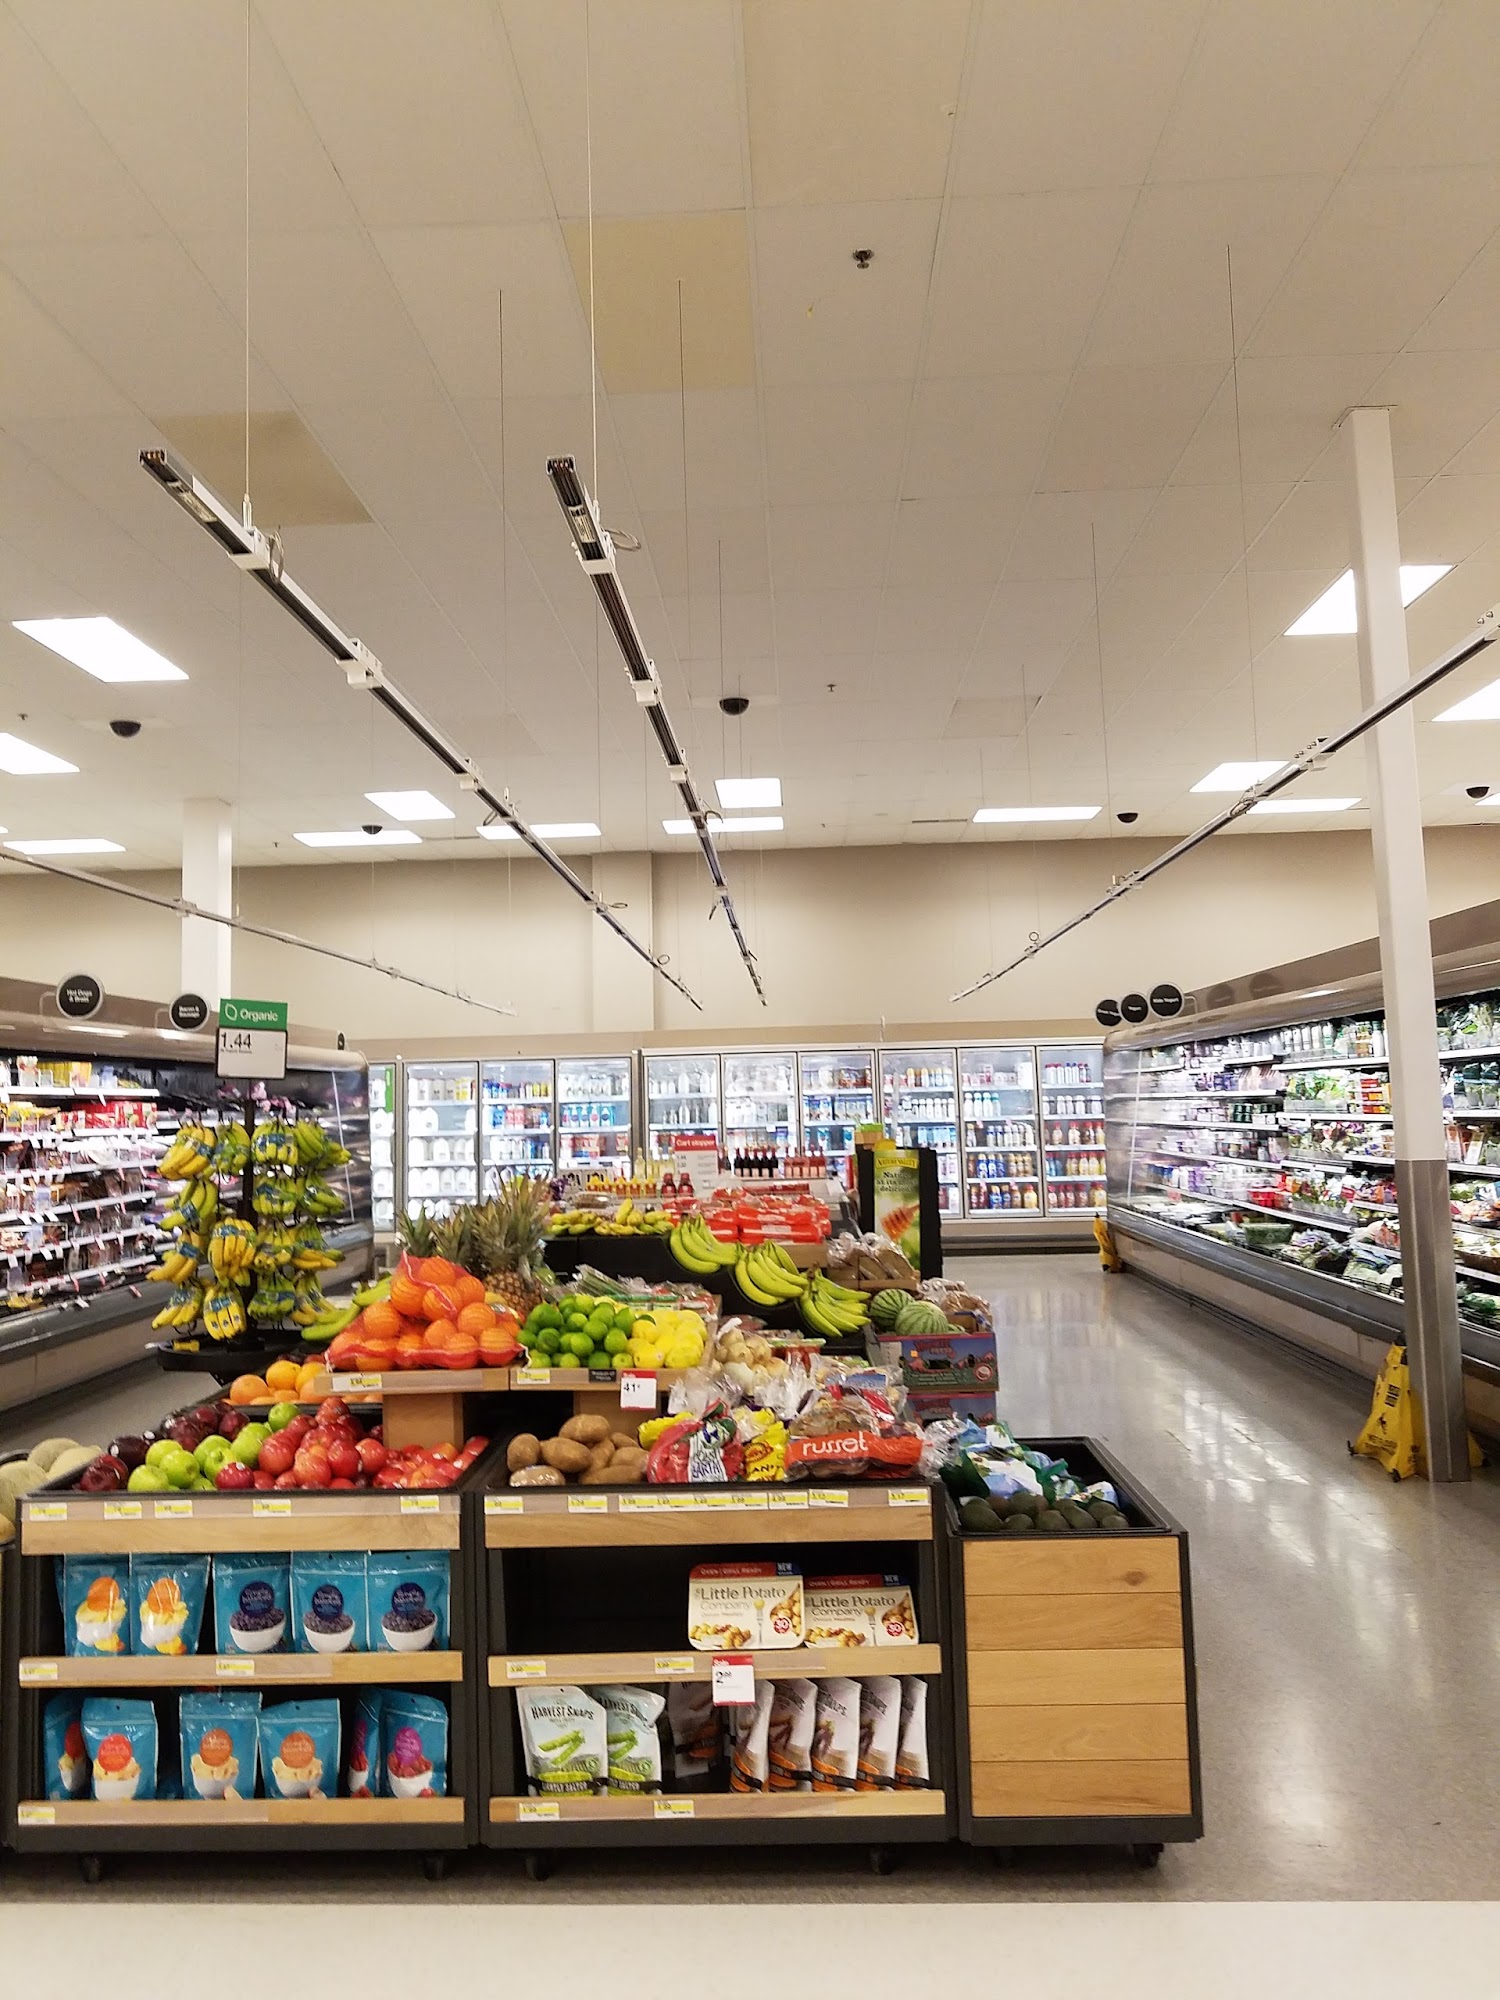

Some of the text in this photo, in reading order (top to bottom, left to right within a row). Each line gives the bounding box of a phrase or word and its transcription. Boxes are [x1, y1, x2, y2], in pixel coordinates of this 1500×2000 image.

[240, 1008, 279, 1023] Organic
[221, 1032, 252, 1049] 1.44
[676, 1139, 691, 1147] Cart
[802, 1431, 868, 1456] russet
[777, 1562, 793, 1571] NEW
[700, 1585, 786, 1600] Little Potato
[809, 1595, 896, 1608] Little Potato
[810, 1607, 862, 1618] Company
[531, 1705, 566, 1720] HARVEST
